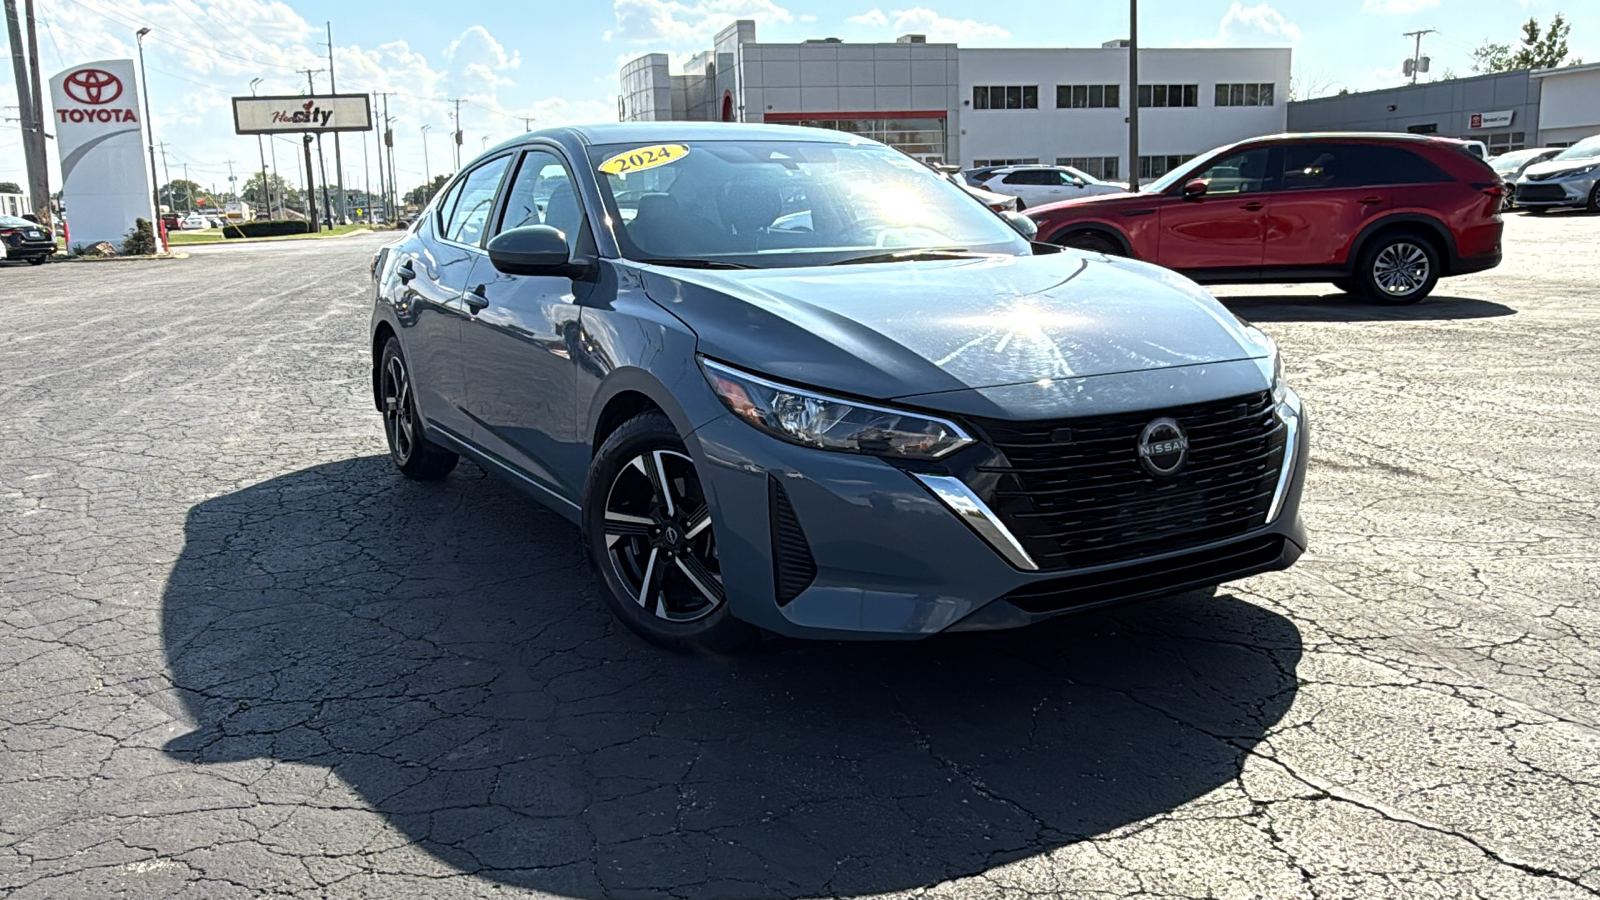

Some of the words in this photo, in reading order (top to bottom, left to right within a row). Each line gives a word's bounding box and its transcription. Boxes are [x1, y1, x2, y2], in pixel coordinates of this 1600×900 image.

[56, 108, 137, 123] TOYOTA
[613, 146, 671, 172] 2024
[1140, 438, 1188, 455] NISSAN
